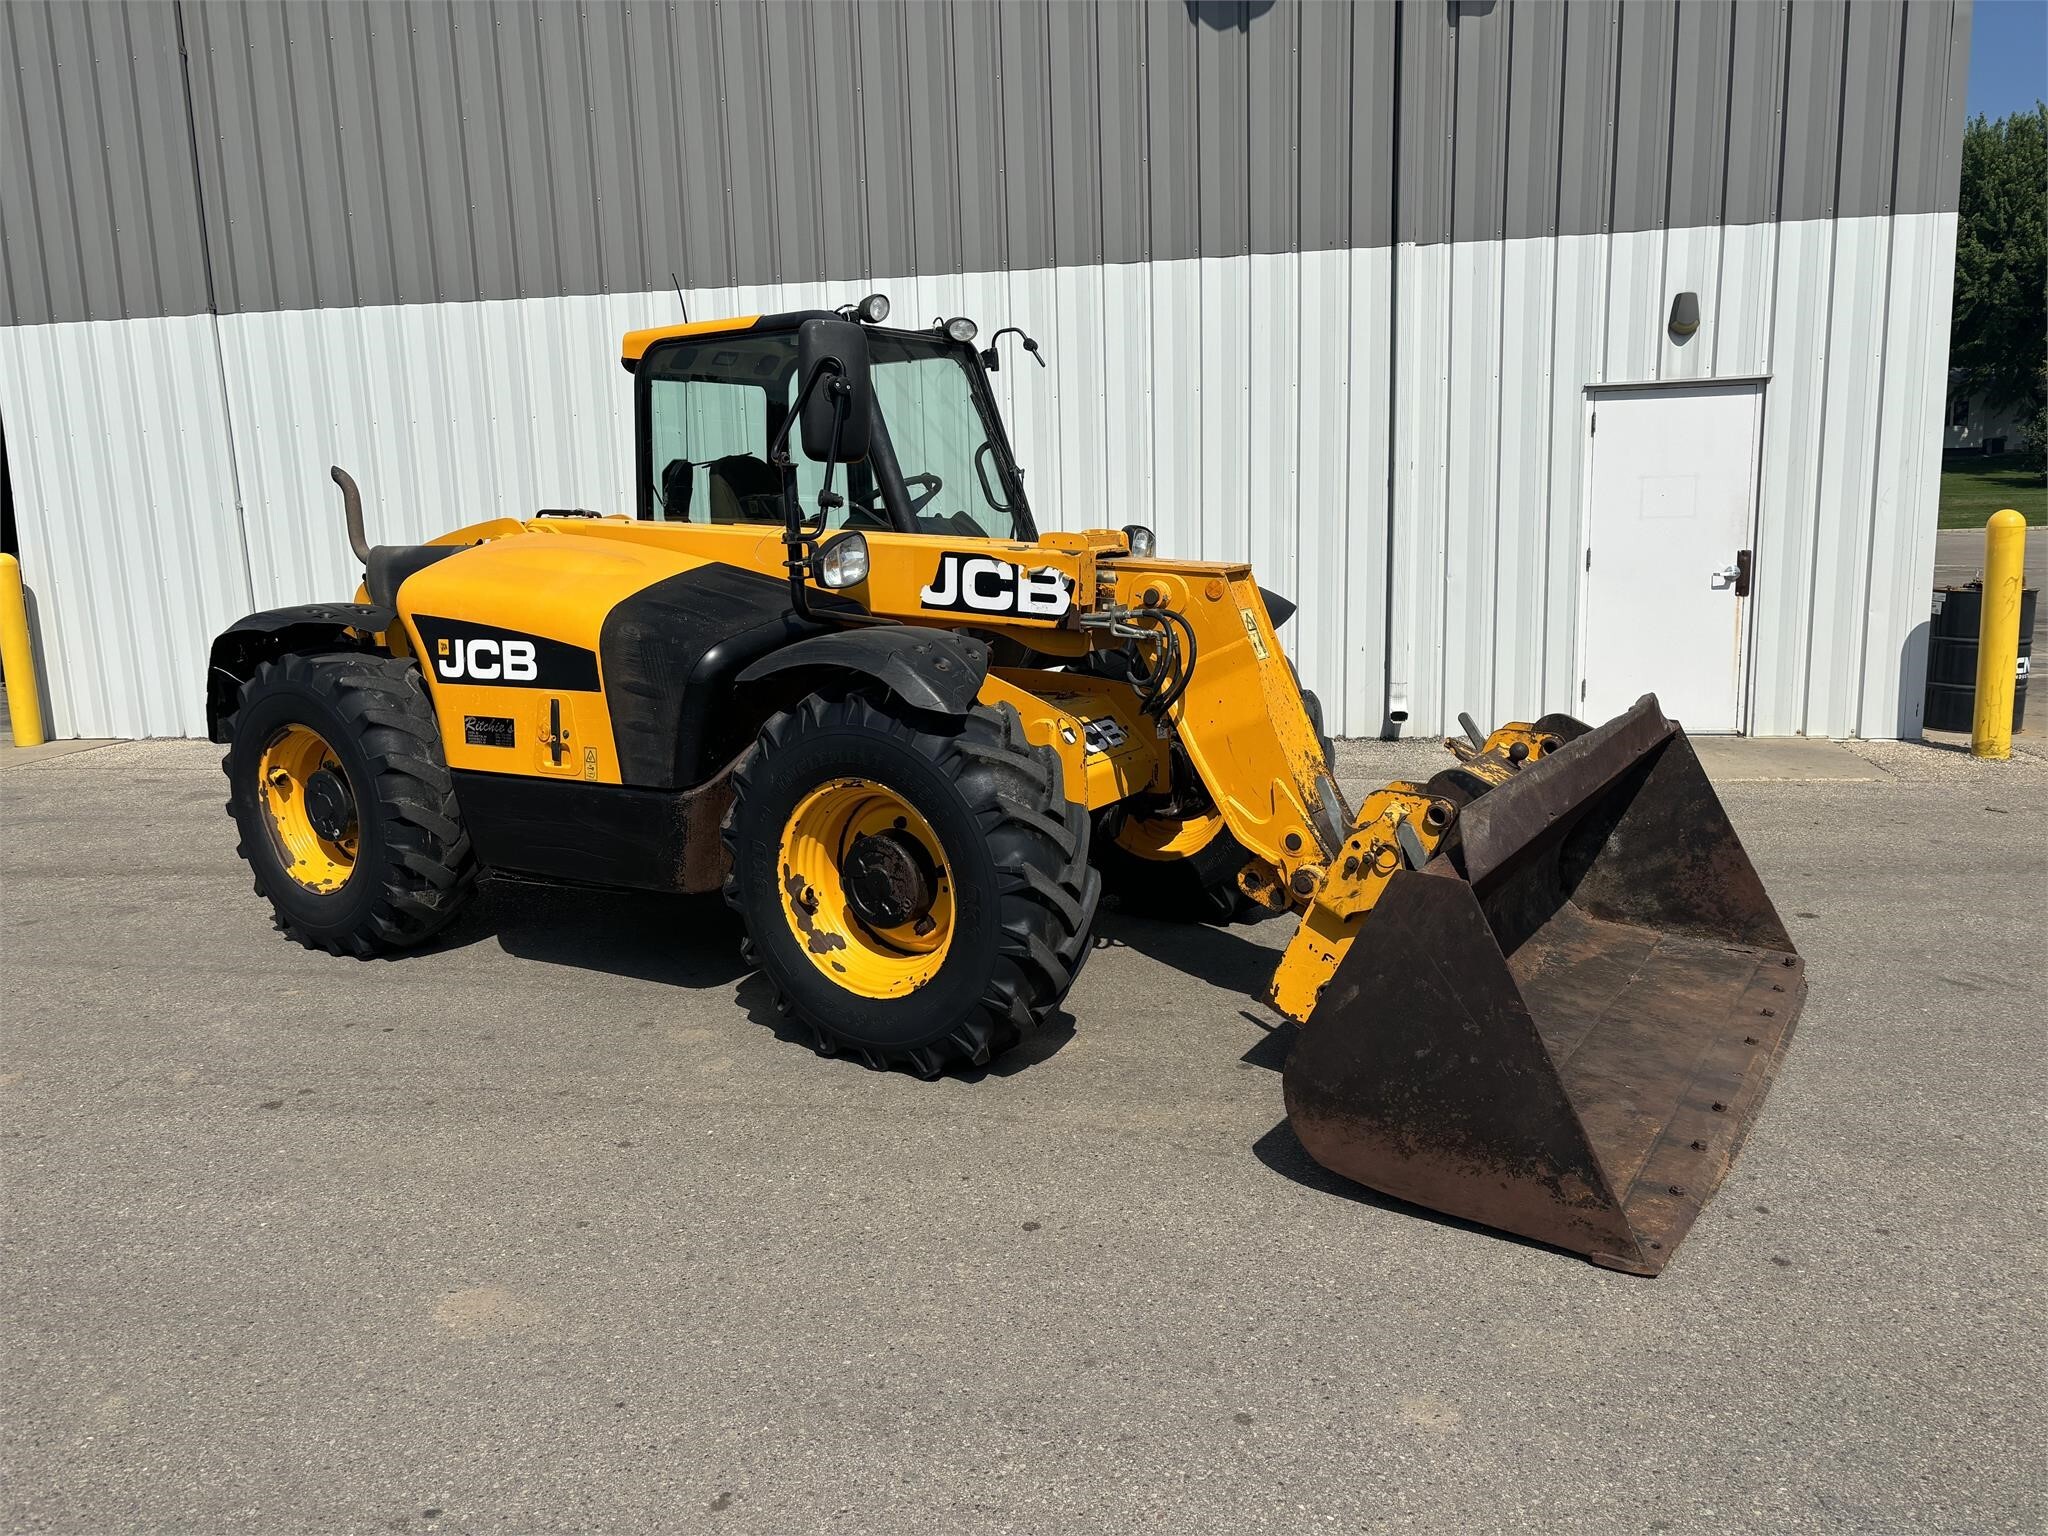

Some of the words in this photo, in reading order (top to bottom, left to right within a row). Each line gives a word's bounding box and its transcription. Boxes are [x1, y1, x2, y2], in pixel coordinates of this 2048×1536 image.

[920, 557, 1071, 616] JCB
[438, 639, 538, 681] JCB
[465, 717, 514, 733] Ritchie's
[1084, 719, 1125, 752] CB
